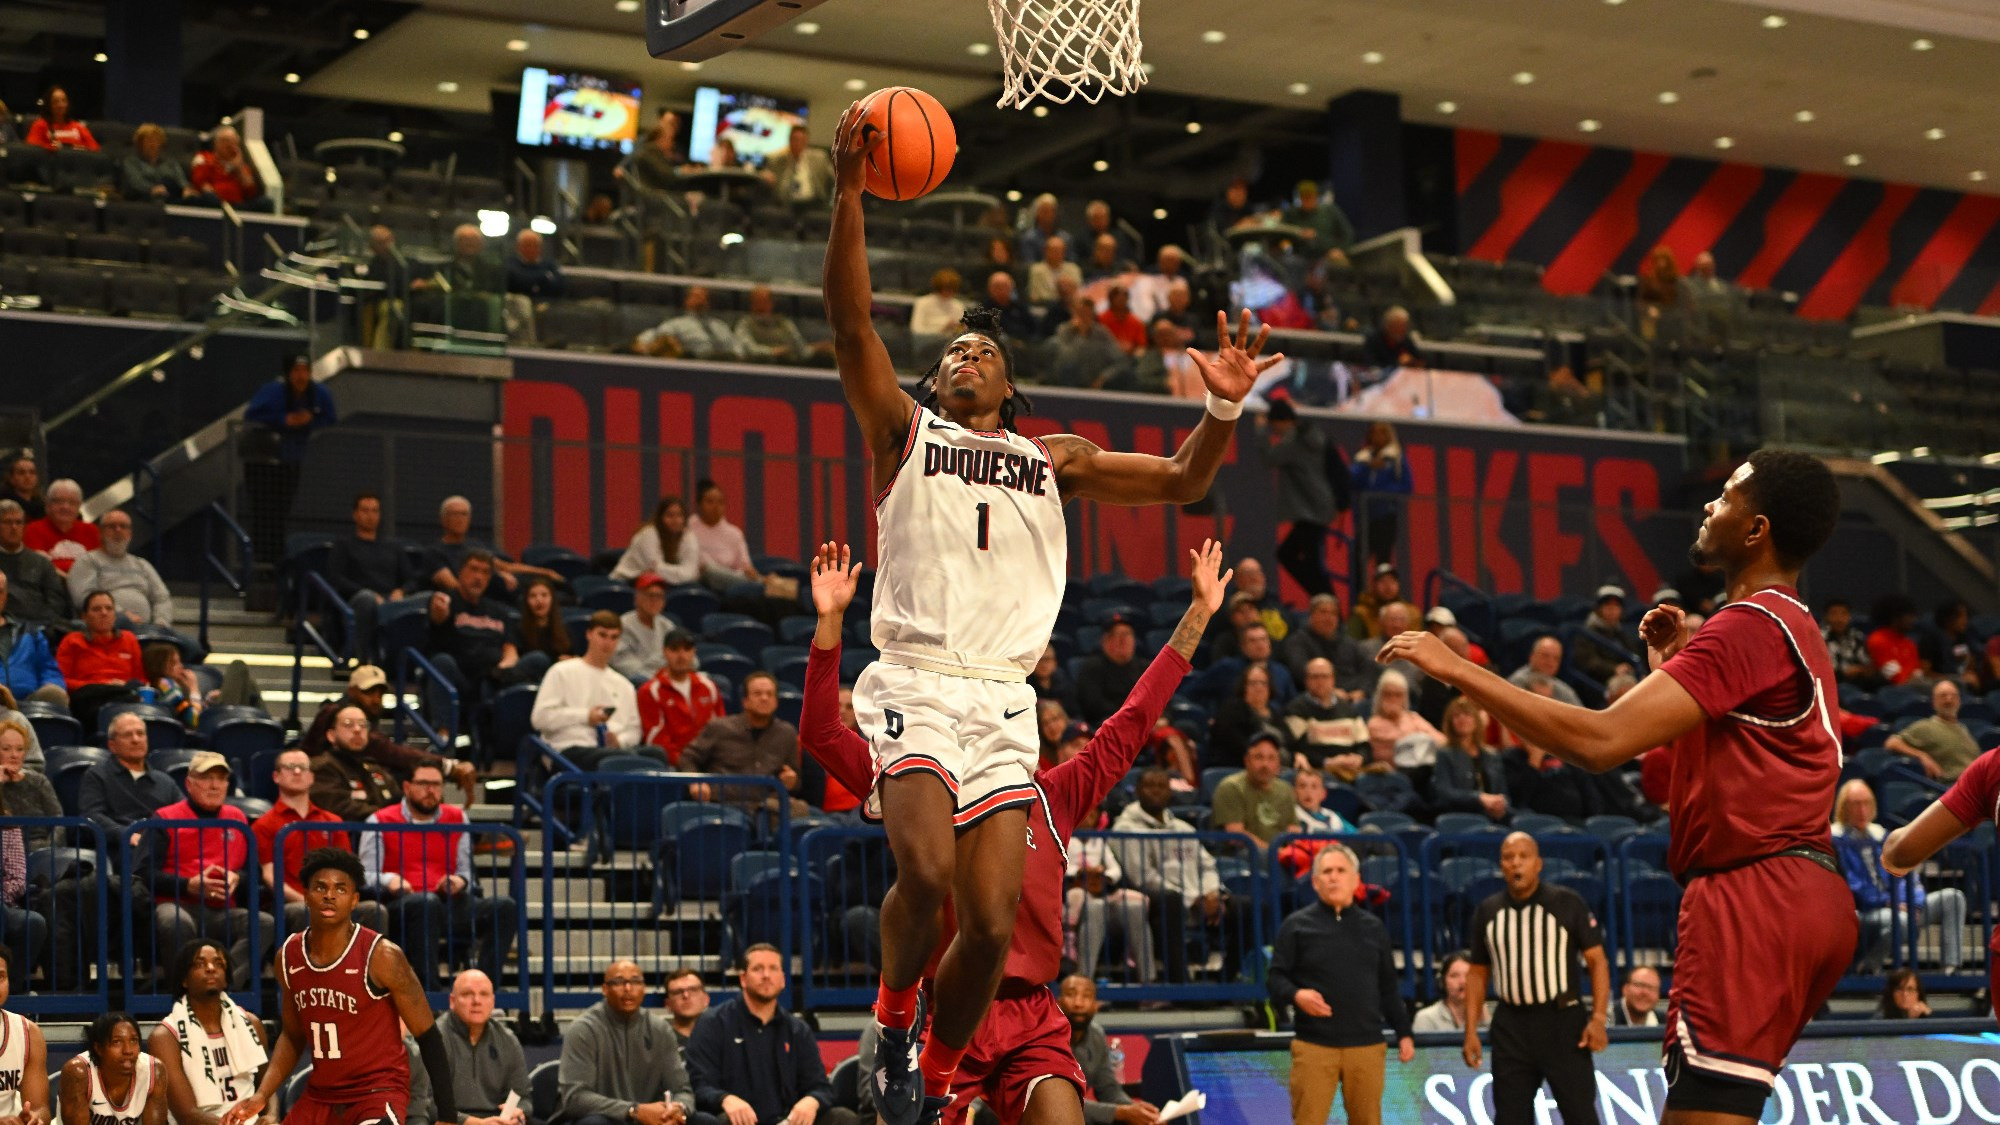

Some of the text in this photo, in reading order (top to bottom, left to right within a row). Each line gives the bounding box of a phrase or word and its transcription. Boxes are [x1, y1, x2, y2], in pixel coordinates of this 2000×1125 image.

[924, 441, 1048, 496] DUQUESNE
[503, 379, 1664, 618] DUQUNE KES
[976, 502, 990, 550] 1
[294, 987, 358, 1014] SC STATE
[310, 1021, 341, 1059] 11
